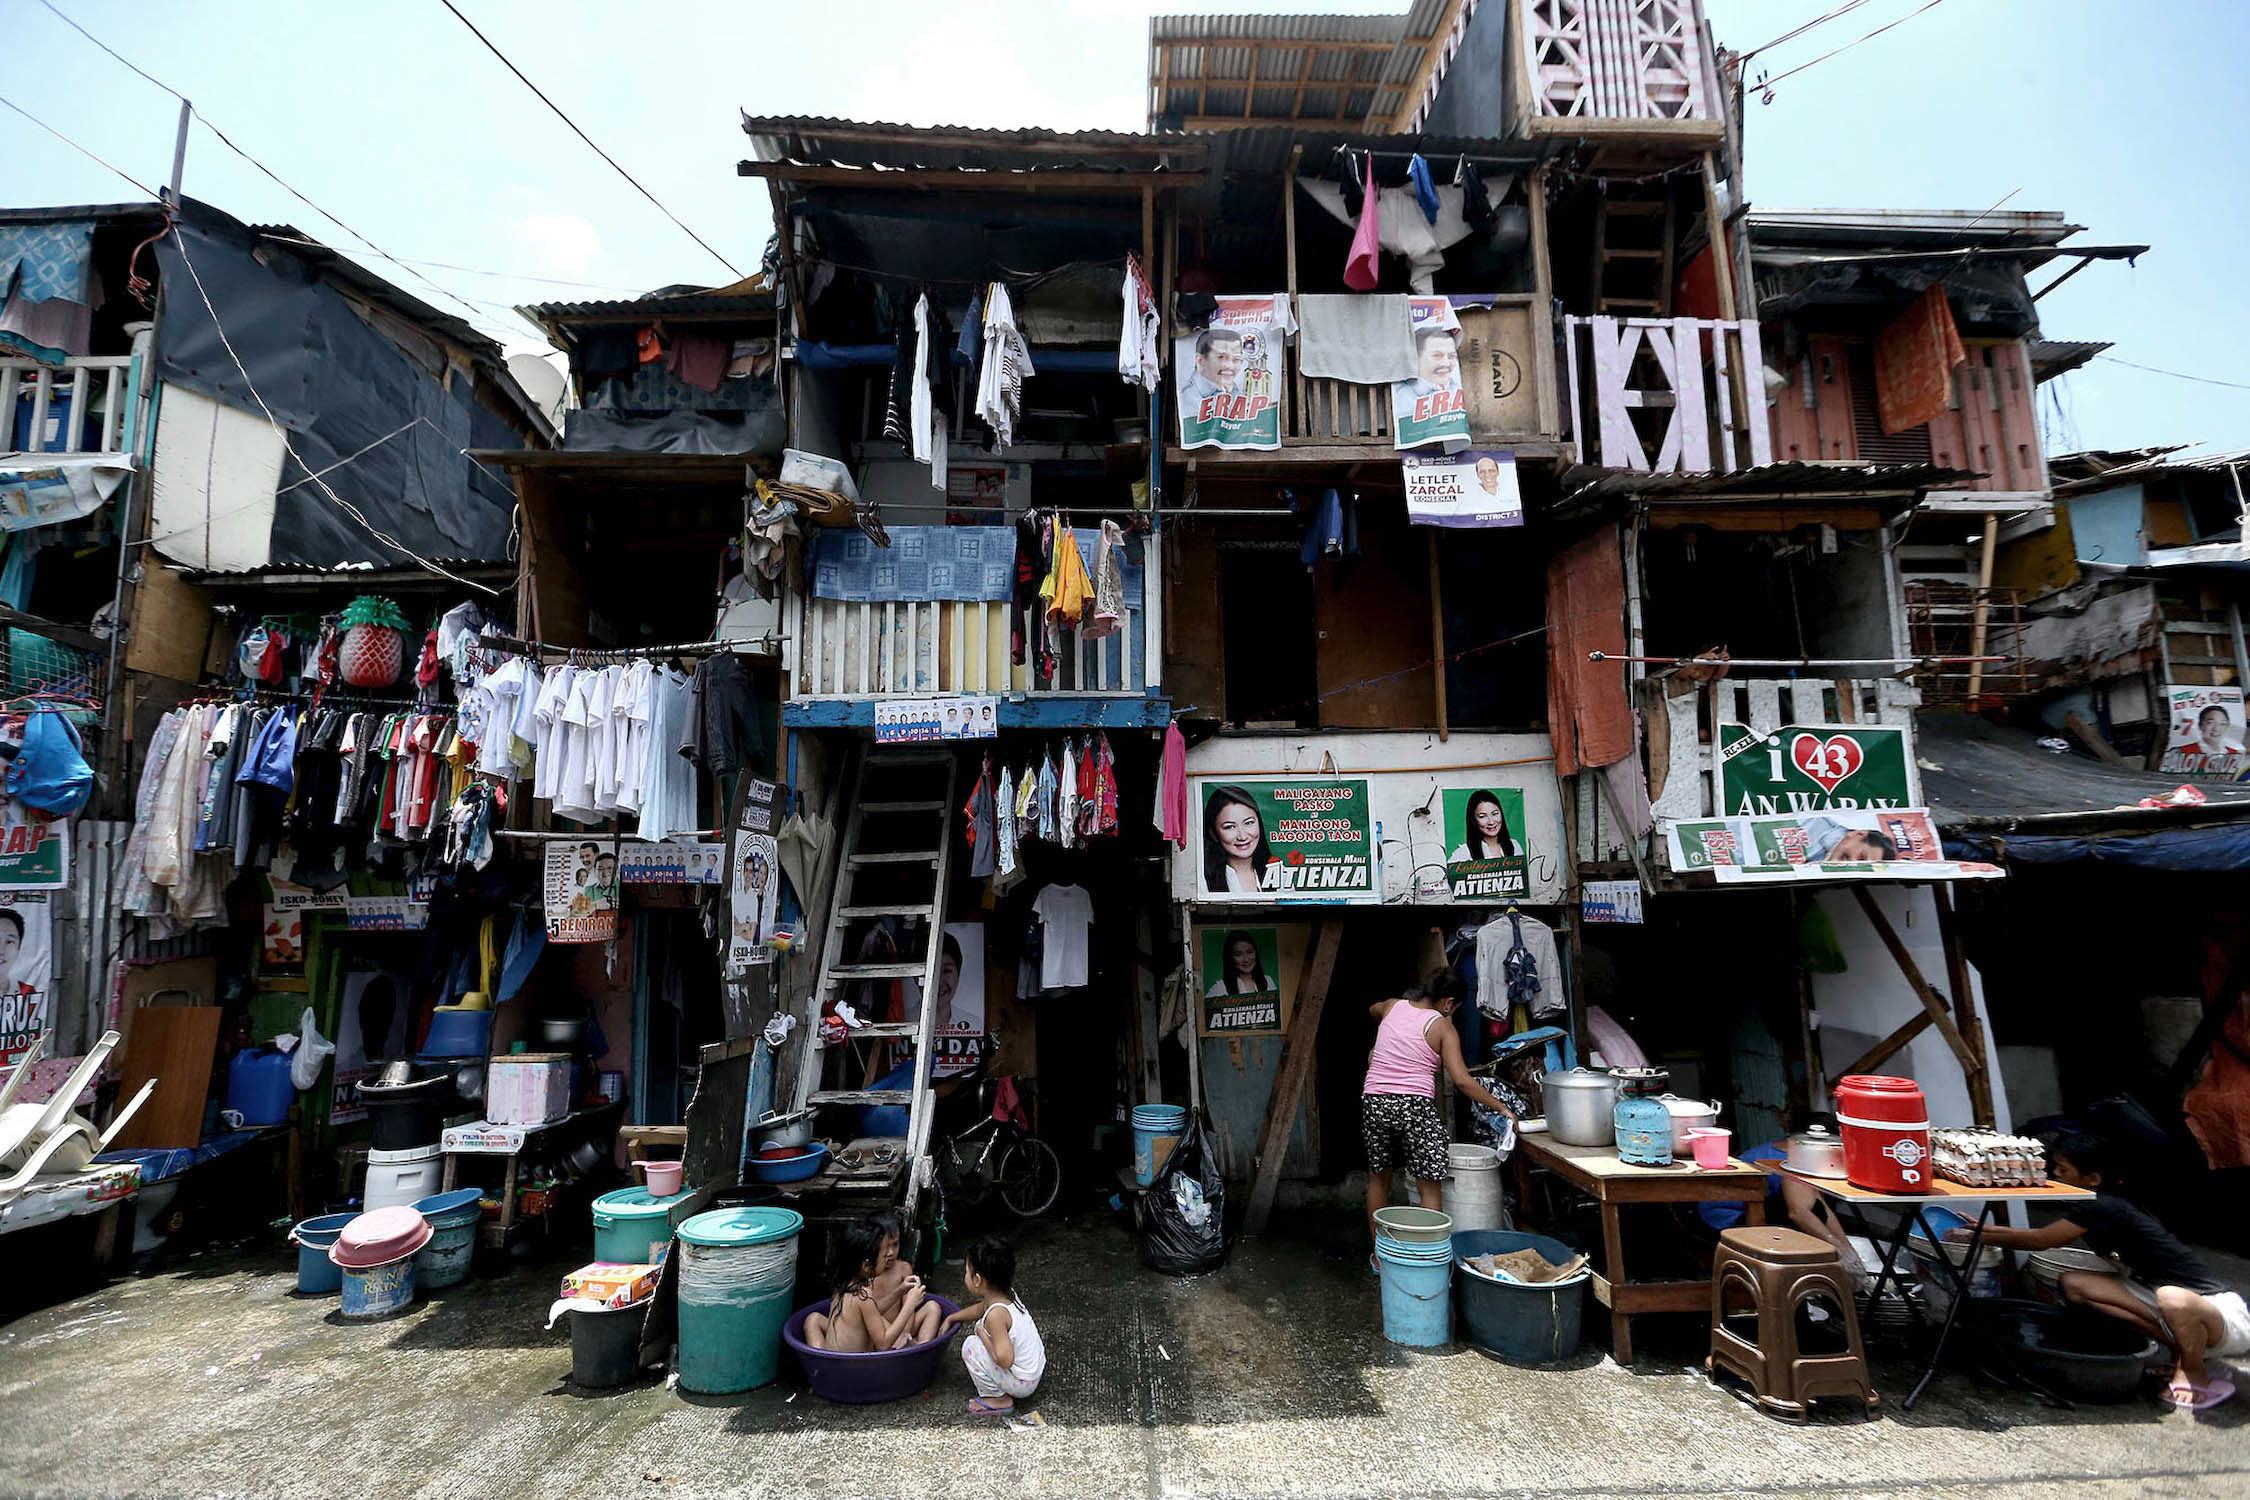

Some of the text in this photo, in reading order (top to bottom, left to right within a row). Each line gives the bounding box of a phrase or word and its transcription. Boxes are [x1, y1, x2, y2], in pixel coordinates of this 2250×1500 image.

[1197, 393, 1268, 423] ERAP
[1413, 389, 1466, 423] ERA
[1411, 474, 1458, 484] LETLET
[1409, 485, 1464, 495] ZARCAL
[1475, 512, 1510, 521] DISTRICT
[1805, 744, 1850, 779] 43
[1274, 788, 1353, 800] MALIGAYANG
[1738, 790, 1779, 816] AN
[1294, 800, 1334, 811] PASKO
[1279, 819, 1350, 830] MANIGONG
[1270, 830, 1362, 842] BAGONG TAON
[1779, 827, 1807, 864] ESTR
[1705, 830, 1733, 865] ESTR
[1261, 865, 1367, 888] ATIENZA
[1453, 876, 1524, 897] ATIENZA
[551, 917, 615, 937] 5 BELTRAN
[0, 991, 44, 1034] RUZ
[1210, 1009, 1276, 1028] ATIENZA
